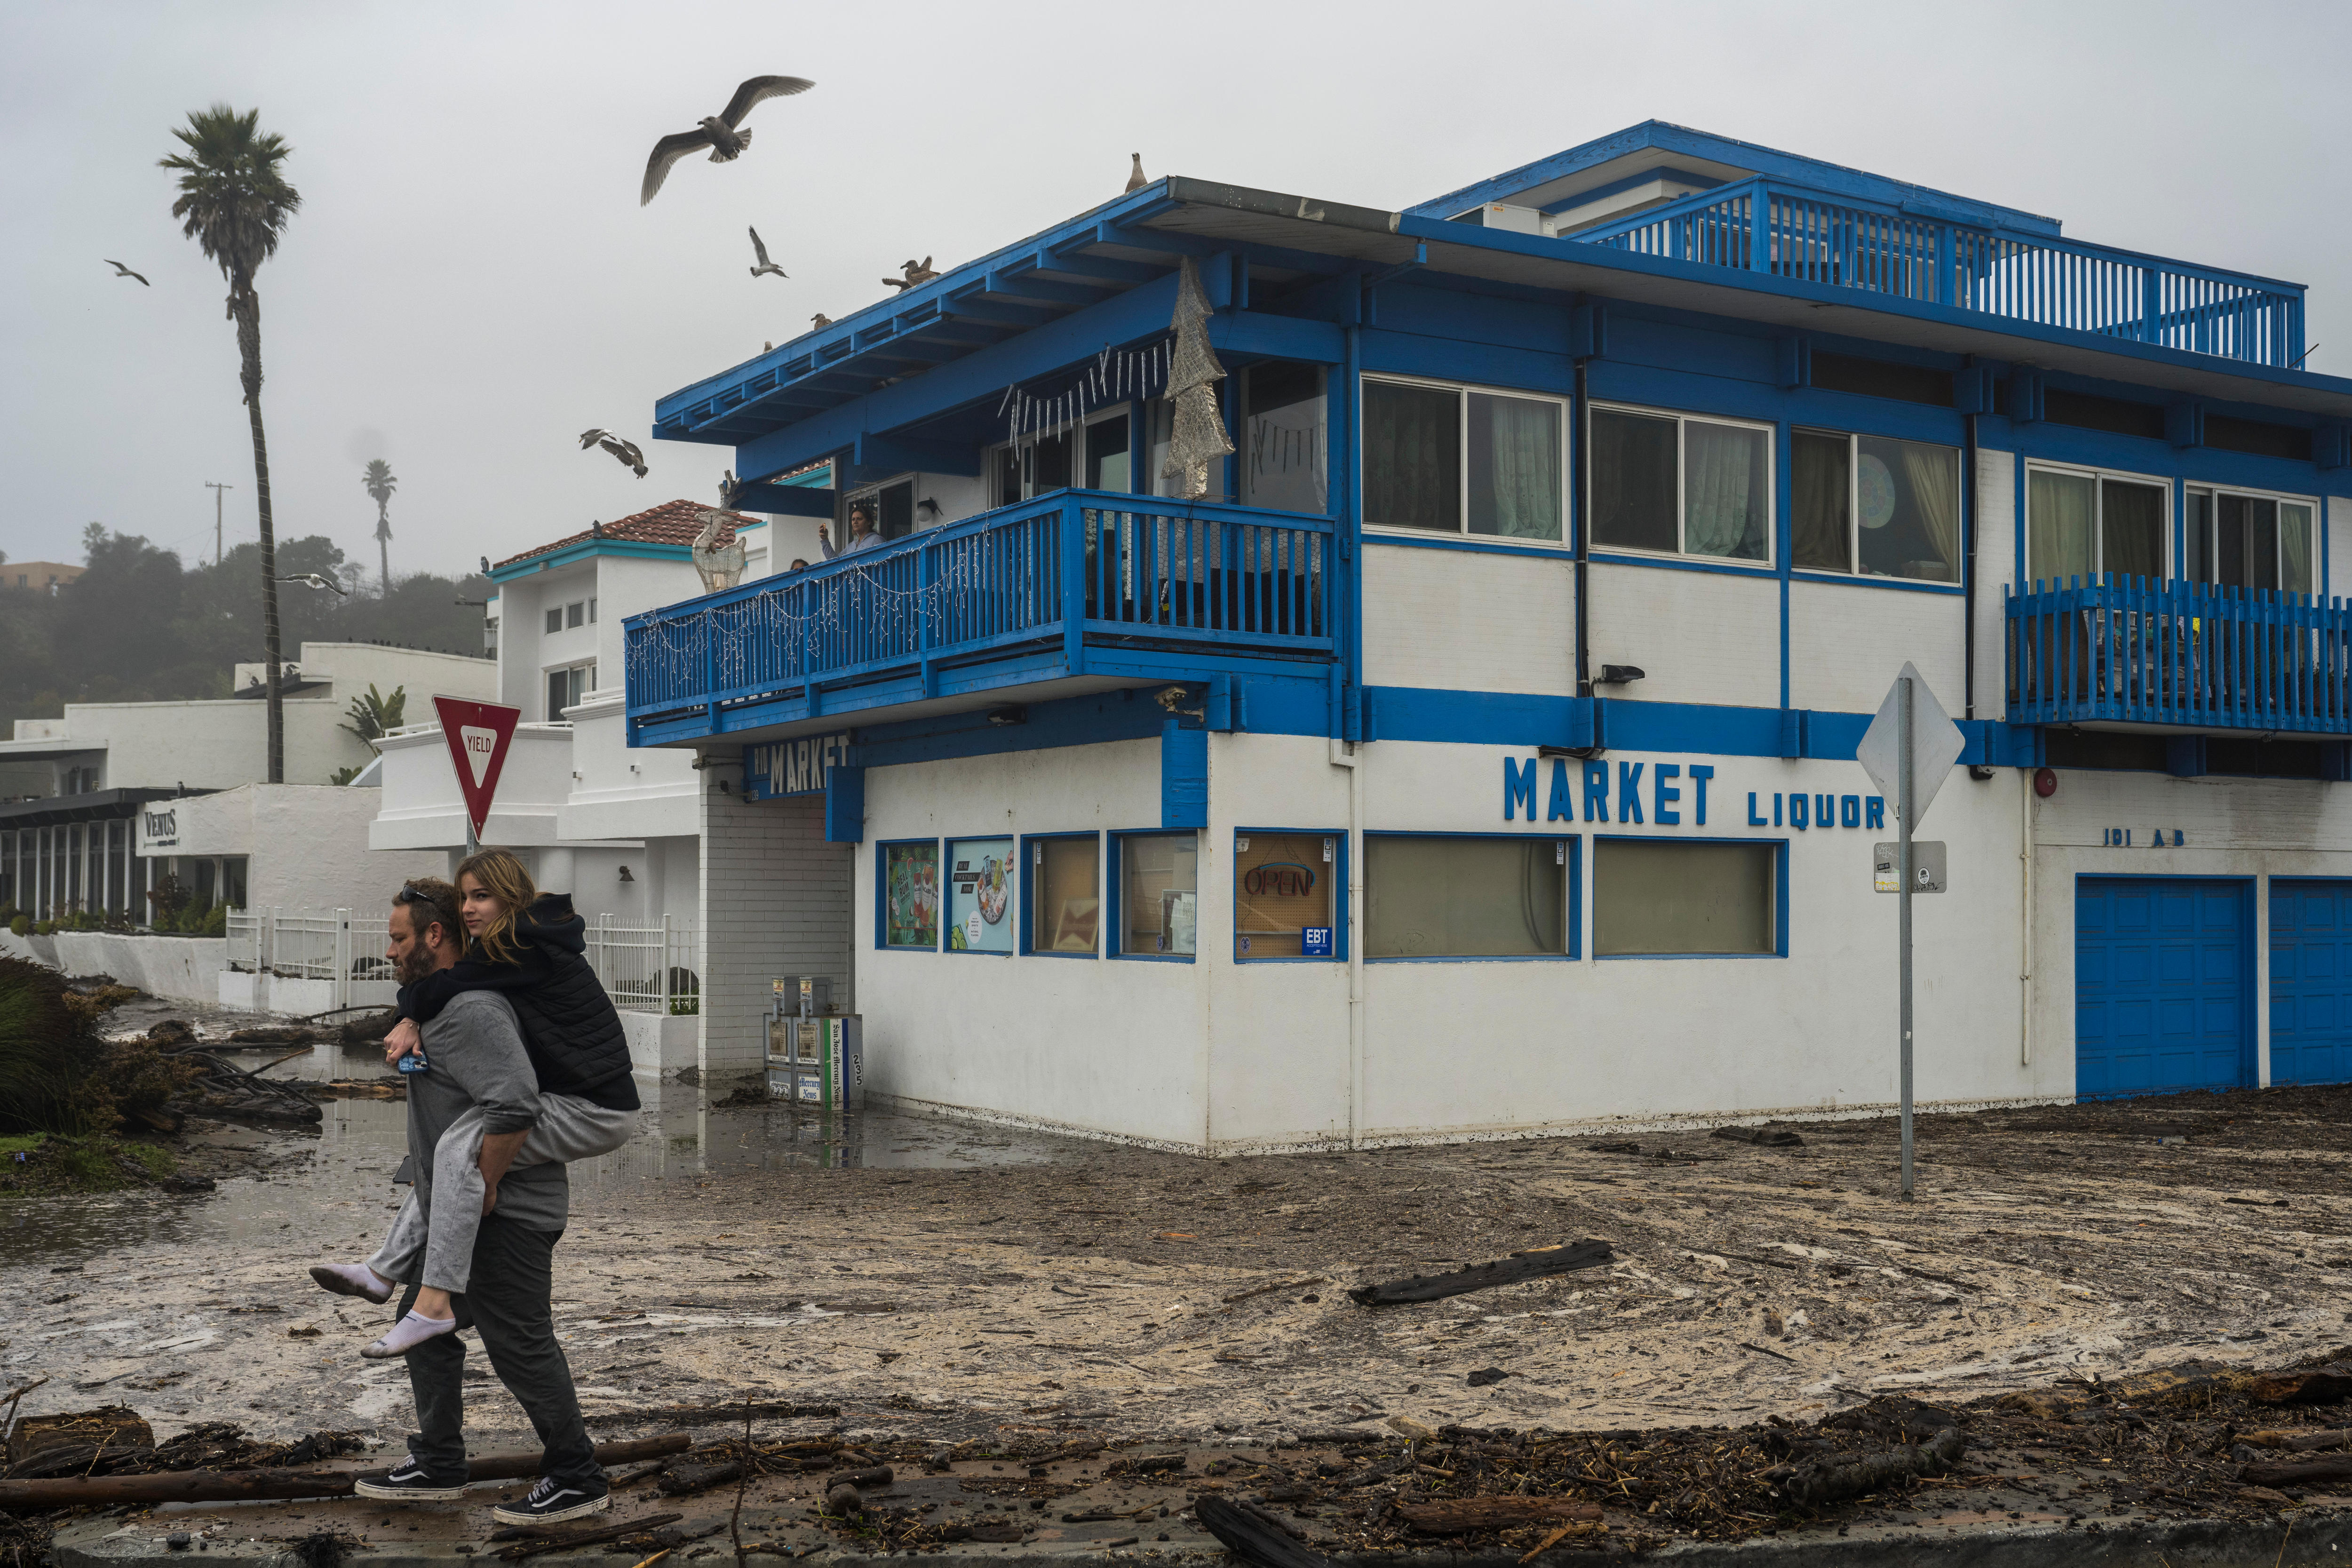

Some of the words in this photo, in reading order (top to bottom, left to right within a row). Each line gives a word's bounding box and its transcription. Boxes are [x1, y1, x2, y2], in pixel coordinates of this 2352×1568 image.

[467, 735, 491, 753] YIELD
[755, 746, 769, 775] RIO
[770, 735, 850, 794] MARKET
[1504, 756, 1714, 826] MARKET
[1748, 791, 1884, 830] LIQUOR
[144, 808, 176, 837] VENUS
[2104, 828, 2131, 846] 101
[897, 871, 908, 887] REAL
[1246, 869, 1311, 897] OPEN
[899, 881, 909, 898] RUM
[1306, 929, 1328, 944] EBT
[853, 1054, 862, 1086] 235
[799, 1077, 820, 1090] Mercury
[803, 1089, 817, 1099] News
